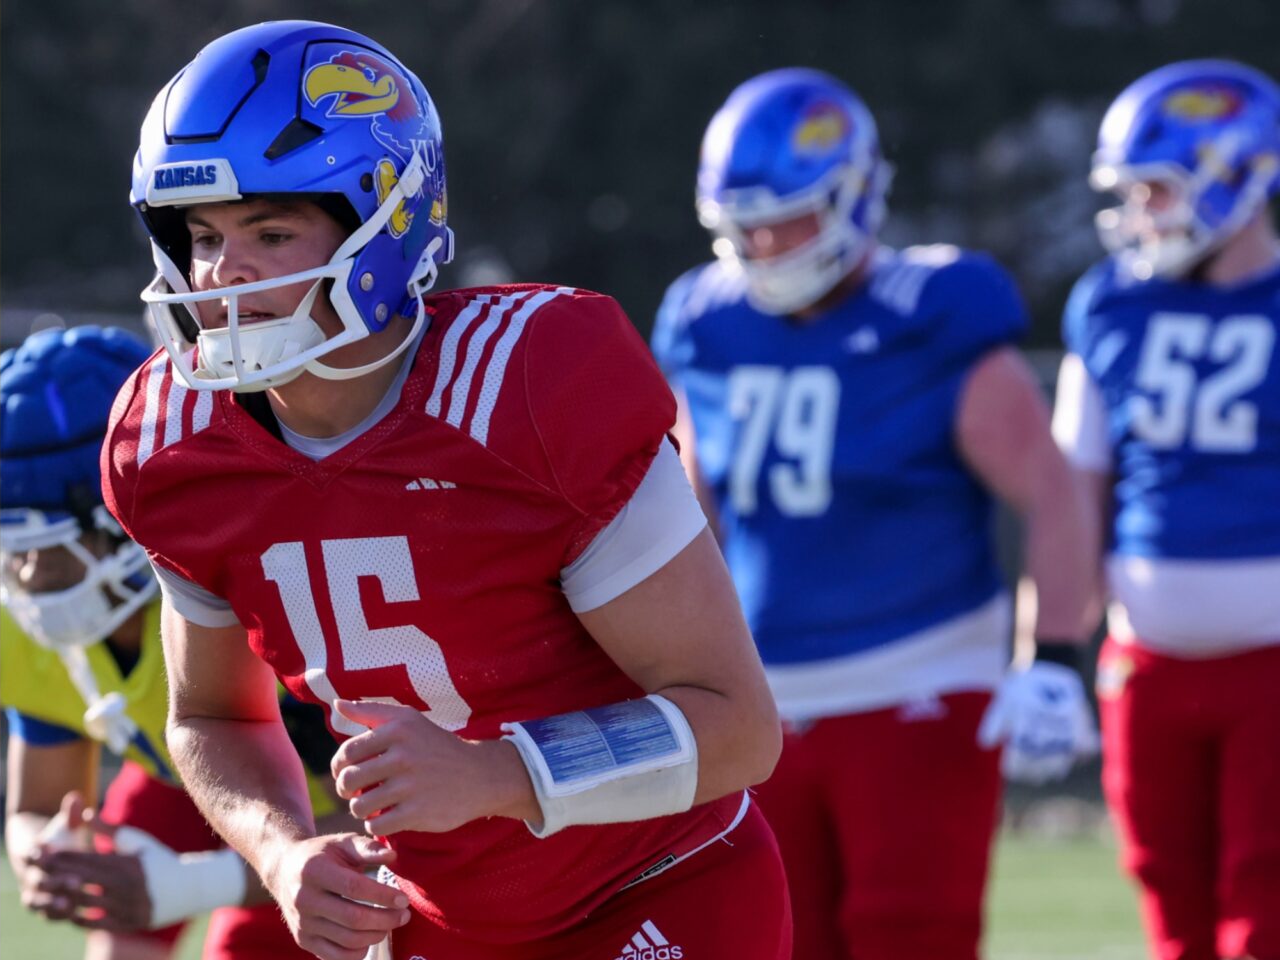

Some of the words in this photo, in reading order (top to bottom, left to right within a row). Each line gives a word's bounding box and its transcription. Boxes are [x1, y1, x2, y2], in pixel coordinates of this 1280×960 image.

[154, 165, 216, 190] KANSAS
[728, 364, 841, 516] 79
[1134, 312, 1276, 453] 52
[260, 535, 472, 737] 15
